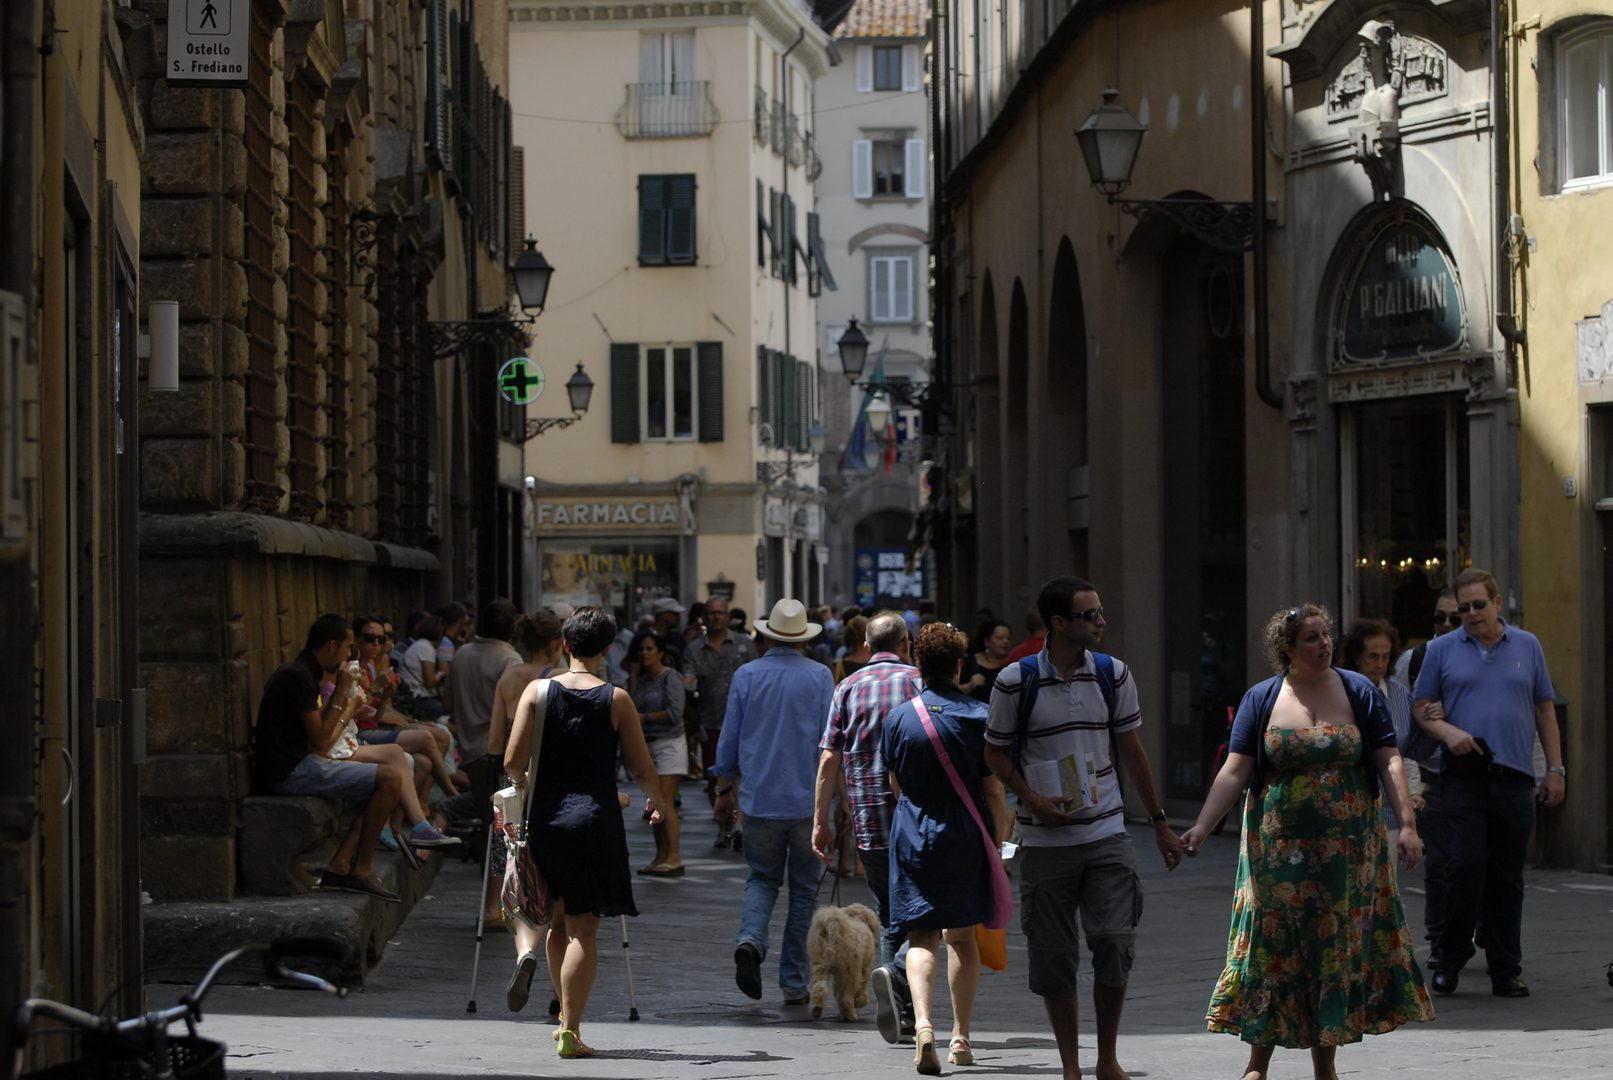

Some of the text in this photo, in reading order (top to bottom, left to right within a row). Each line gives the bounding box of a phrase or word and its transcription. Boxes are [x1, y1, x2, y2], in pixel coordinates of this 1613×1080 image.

[186, 43, 230, 55] Ostello
[173, 60, 242, 73] S. Frediano
[537, 503, 677, 524] FARMACIA
[568, 551, 657, 573] ARMACIA
